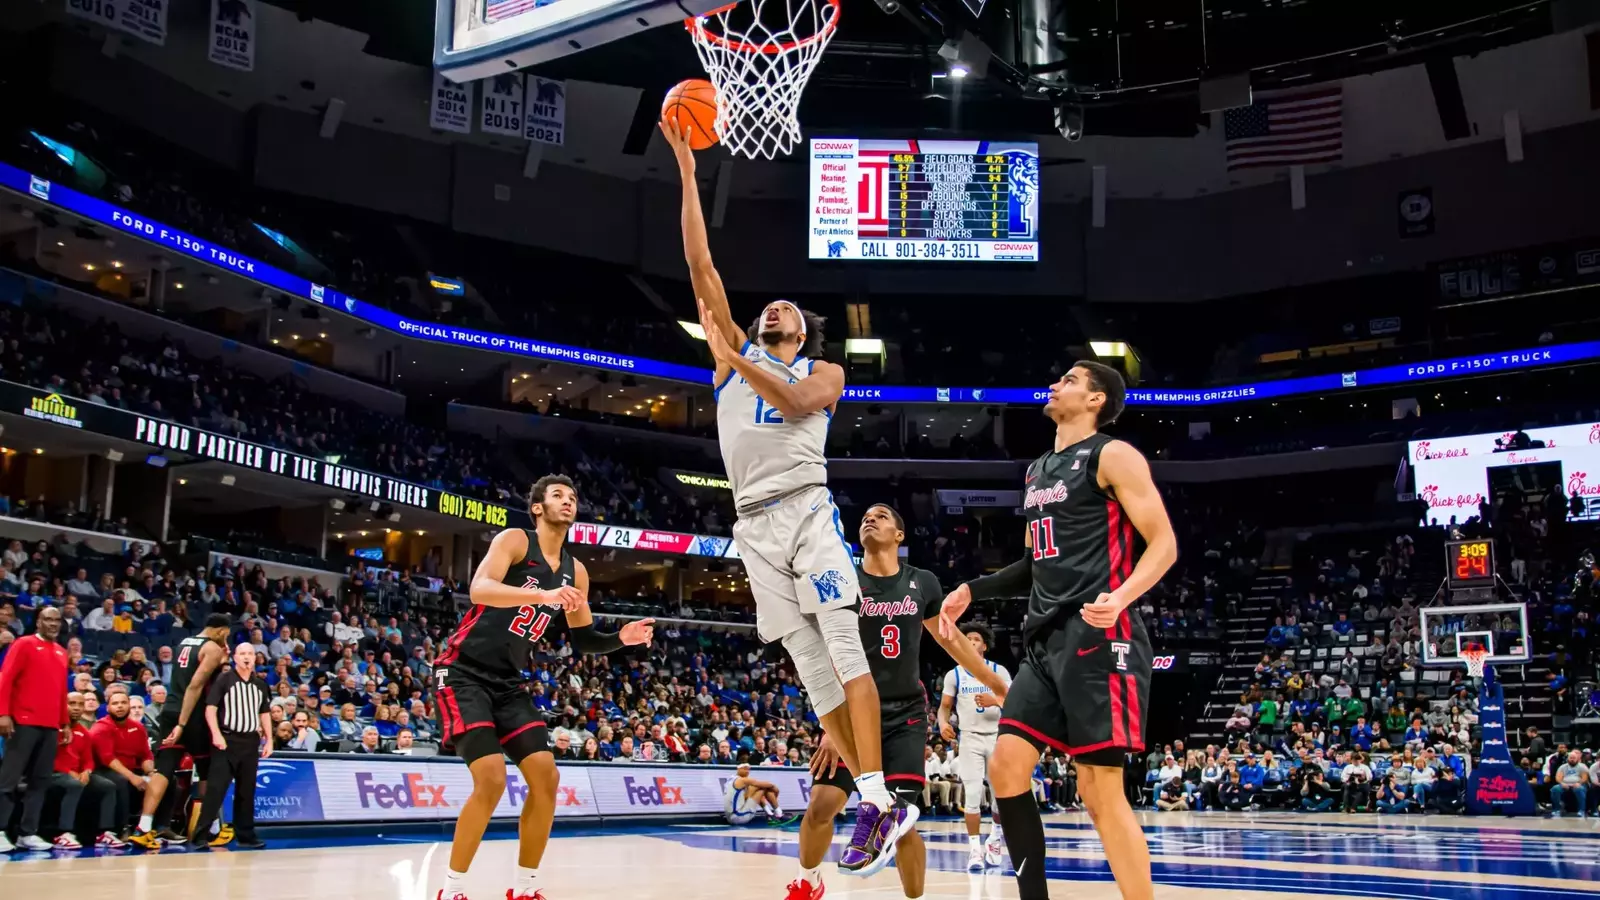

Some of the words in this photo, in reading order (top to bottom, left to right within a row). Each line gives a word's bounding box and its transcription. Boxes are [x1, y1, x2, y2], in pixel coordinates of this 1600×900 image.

[215, 23, 249, 40] NCAA
[216, 36, 248, 53] 2012
[437, 88, 467, 104] NCAA
[437, 100, 465, 115] 2014
[533, 103, 558, 118] NIT
[485, 113, 520, 130] 2019
[526, 126, 561, 144] 2021
[822, 163, 846, 171] Official
[924, 155, 946, 164] FIELD
[947, 155, 974, 164] GOALS
[898, 164, 910, 172] 3-7
[922, 164, 937, 173] 3-PT
[937, 164, 955, 173] FIELD
[955, 164, 976, 173] GOALS
[821, 174, 847, 183] Heating,
[924, 173, 943, 182] FREE
[943, 173, 973, 182] THROWS
[988, 174, 1001, 182] 3-4
[821, 185, 847, 194] Cooling,
[901, 182, 906, 190] 5
[932, 183, 965, 191] ASSISTS
[818, 196, 849, 205] Plumbing,
[900, 192, 908, 200] 15
[927, 192, 970, 201] REBOUNDS
[992, 193, 997, 201] 11
[815, 206, 821, 214] &
[822, 206, 853, 214] Electrical
[901, 201, 906, 209] 2
[921, 201, 935, 210] OFF
[936, 201, 976, 210] REBOUNDS
[819, 217, 841, 225] Partner
[842, 217, 848, 225] of
[901, 210, 906, 219] 0
[934, 210, 964, 220] STEALS
[813, 228, 828, 236] Tiger
[828, 228, 854, 236] Athletics
[933, 220, 964, 229] BLOCKS
[992, 221, 997, 229] 0
[925, 229, 972, 238] TURNOVERS
[992, 230, 997, 238] 4
[112, 211, 155, 235] FORD
[210, 248, 255, 273] TRUCK
[861, 242, 889, 257] CALL
[895, 242, 980, 258] 901-384-3511
[399, 319, 449, 338] OFFICIAL
[451, 330, 489, 345] TRUCK
[490, 336, 506, 347] OF
[508, 339, 529, 351] THE
[531, 343, 581, 360] MEMPHIS
[582, 352, 635, 368] GRIZZLIES
[1408, 364, 1445, 376] FORD
[1501, 351, 1551, 364] TRUCK
[842, 389, 881, 397] TRUCK
[1133, 393, 1152, 401] THE
[1154, 393, 1201, 402] MEMPHIS
[1203, 387, 1256, 401] GRIZZLIES
[136, 416, 190, 451] PROUD
[197, 432, 263, 469] PARTNER
[270, 450, 287, 474] OF
[294, 456, 317, 482] THE
[324, 463, 381, 497] MEMPHIS
[388, 479, 428, 508] TIGERS
[439, 491, 463, 518] (901)
[465, 499, 508, 527] 290-8625
[676, 474, 706, 486] KONICA
[706, 478, 732, 489] MINOL
[1024, 479, 1068, 511] Temple
[615, 529, 630, 546] 24
[1030, 516, 1059, 561] 11
[1460, 543, 1488, 557] 3:09
[1456, 557, 1486, 579] 24
[859, 595, 918, 621] Temple
[508, 604, 551, 643] 24
[880, 624, 901, 659] 3
[177, 646, 192, 668] 4
[1110, 642, 1130, 670] T
[434, 669, 449, 690] T
[961, 685, 990, 694] Memphi
[354, 771, 450, 809] FedEx
[623, 776, 687, 806] FedEx
